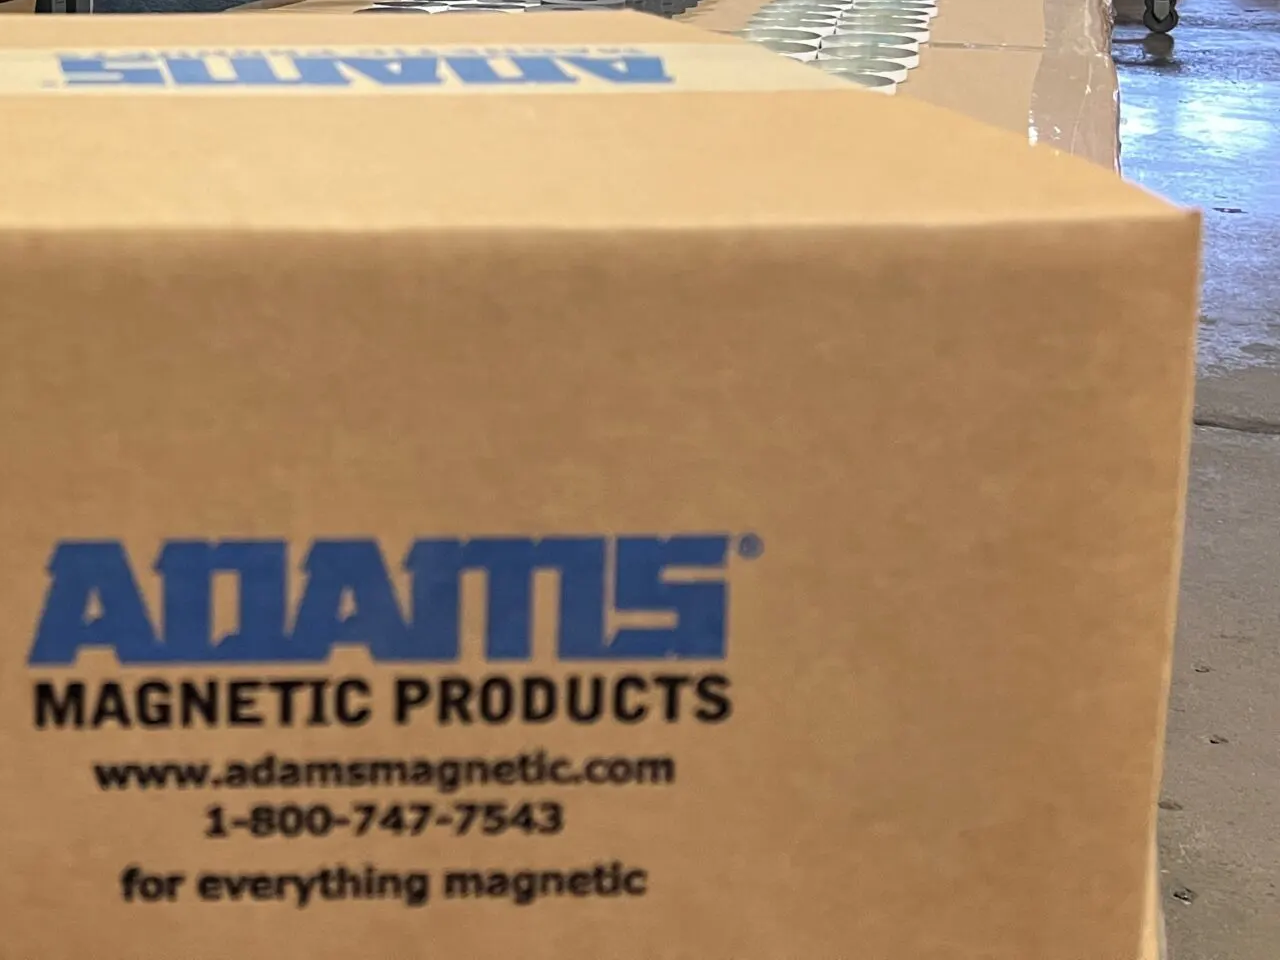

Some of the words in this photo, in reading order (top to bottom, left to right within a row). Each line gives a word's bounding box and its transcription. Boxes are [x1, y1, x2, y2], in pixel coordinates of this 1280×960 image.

[31, 675, 373, 731] MAGNETIC
[393, 671, 733, 727] PRODUCTS
[92, 748, 676, 794] www.adamsmagnetic.com
[204, 800, 565, 840] 1-800-747-7543
[119, 864, 183, 903] for
[196, 862, 431, 909] everything
[442, 858, 648, 907] magnetic
